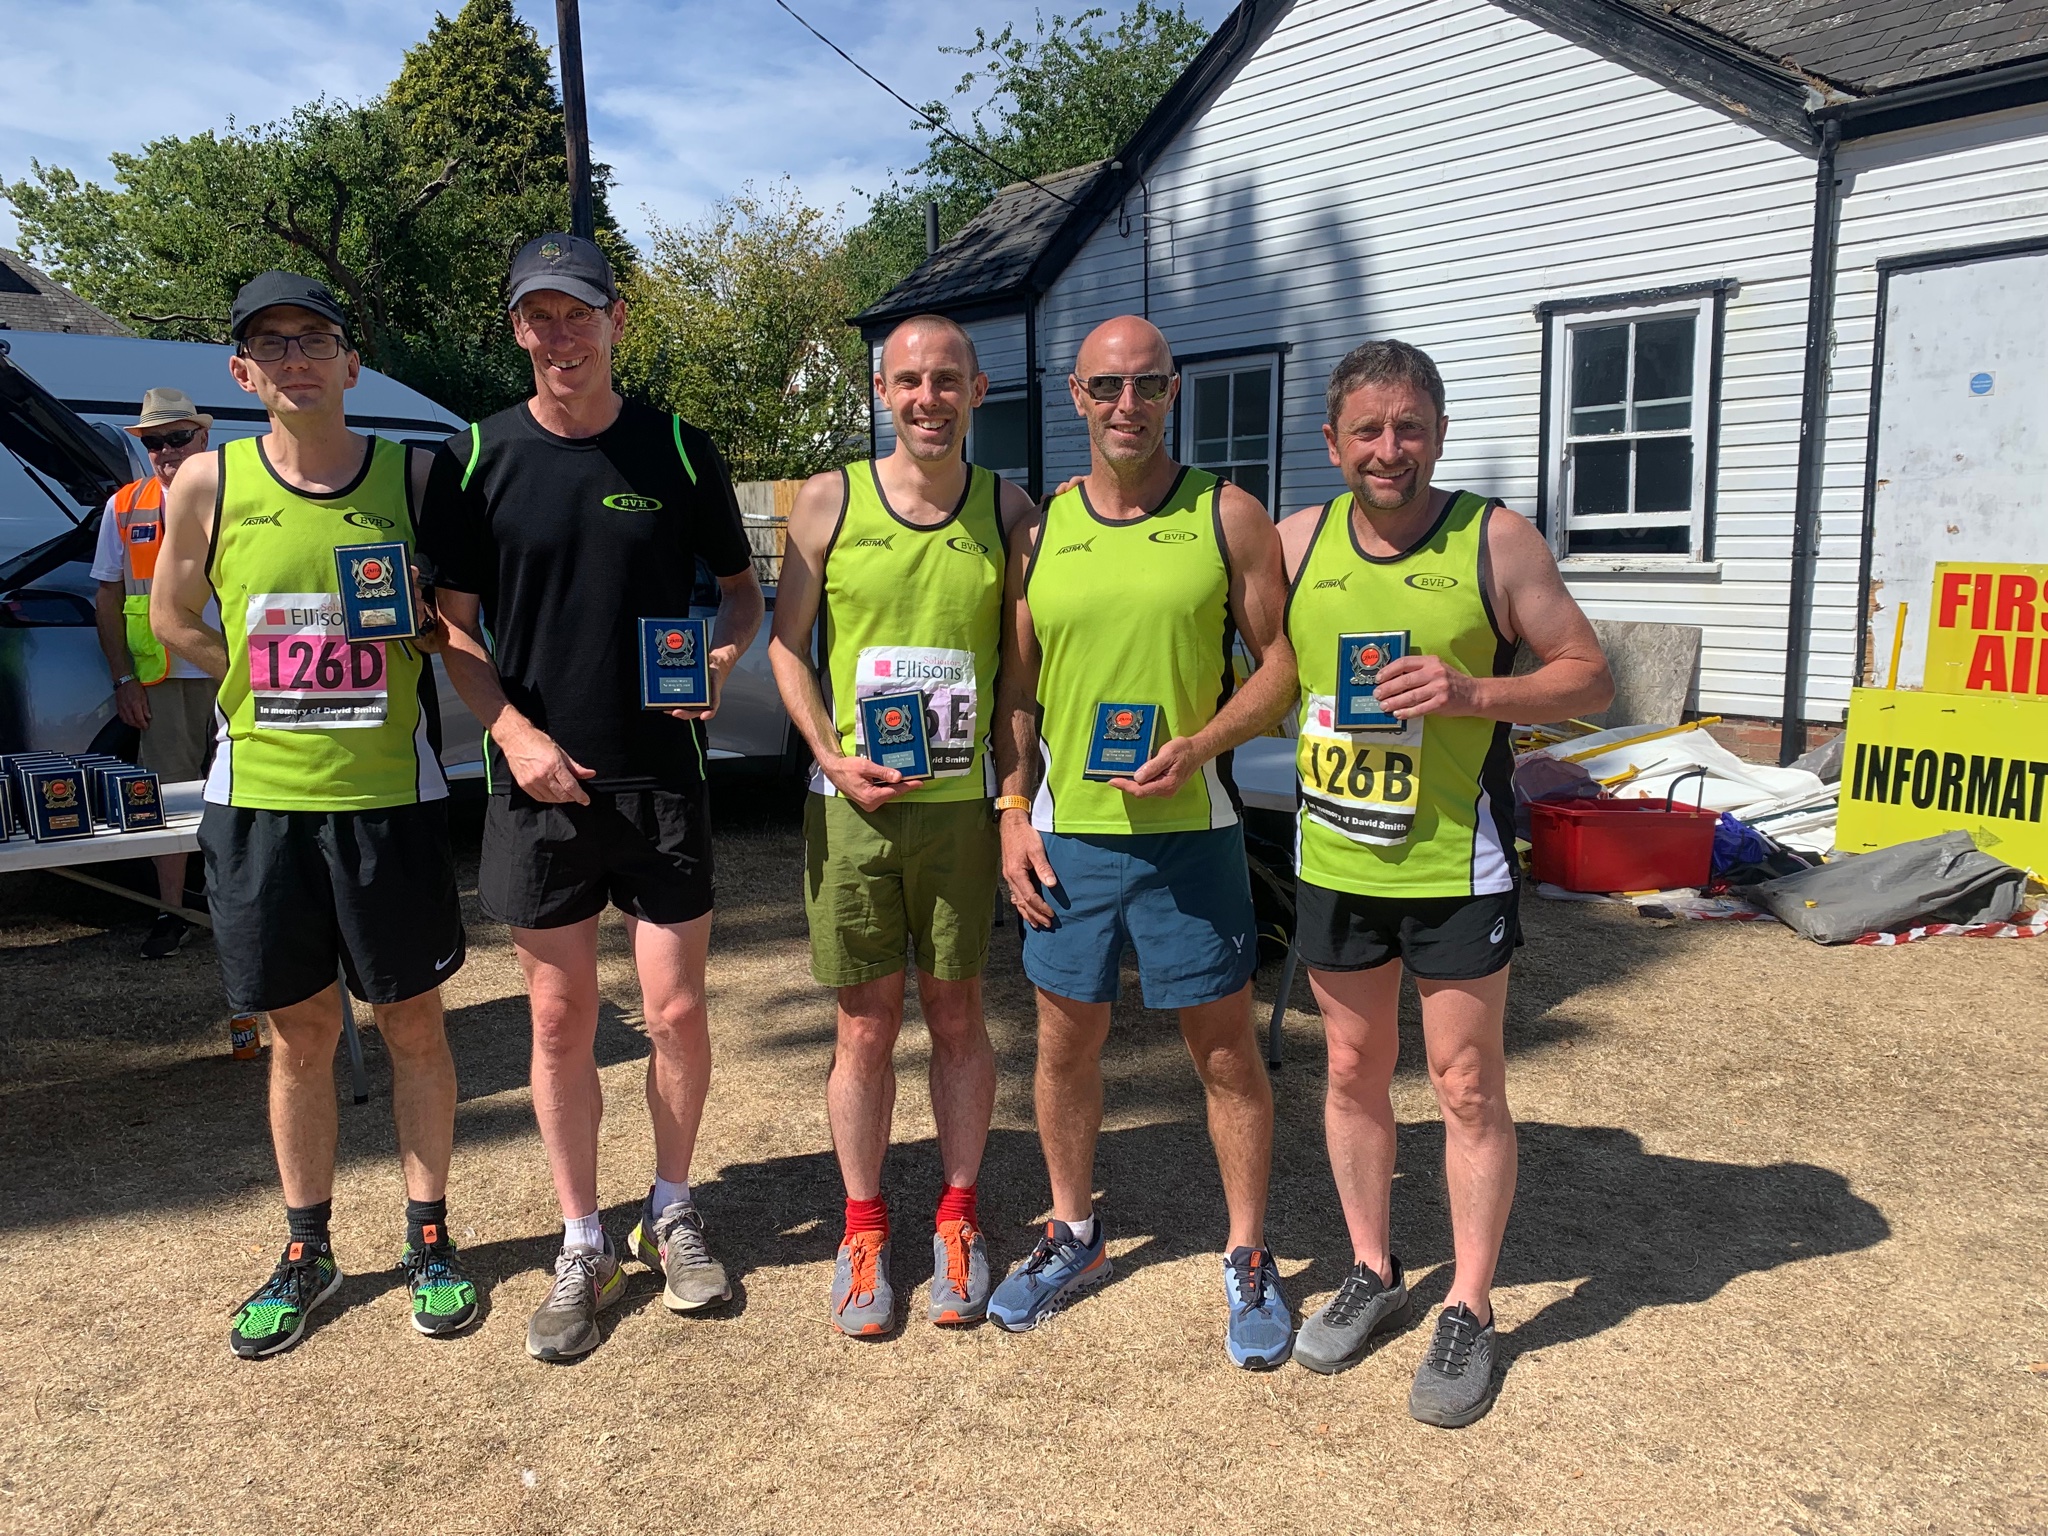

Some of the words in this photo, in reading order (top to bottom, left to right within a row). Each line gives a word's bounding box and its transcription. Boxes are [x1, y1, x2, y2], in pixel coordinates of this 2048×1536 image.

[620, 498, 648, 508] BVH
[241, 508, 285, 527] FASTRAX
[360, 516, 383, 528] BVH
[855, 533, 897, 551] FASTRAX
[1163, 533, 1186, 541] BVH
[960, 540, 979, 553] BVH
[1313, 572, 1353, 591] FASTRAX
[1420, 577, 1445, 587] BVH
[1938, 572, 2048, 633] FIR
[291, 608, 343, 626] Elliso
[267, 641, 383, 690] 126D
[896, 660, 962, 681] Ellisons
[260, 706, 269, 714] In
[270, 707, 308, 716] memory
[353, 706, 382, 714] Smith
[945, 756, 970, 764] Smith
[1311, 742, 1413, 803] 126B
[1317, 805, 1342, 821] memory
[1351, 817, 1378, 828] David
[1378, 821, 1407, 831] Smith
